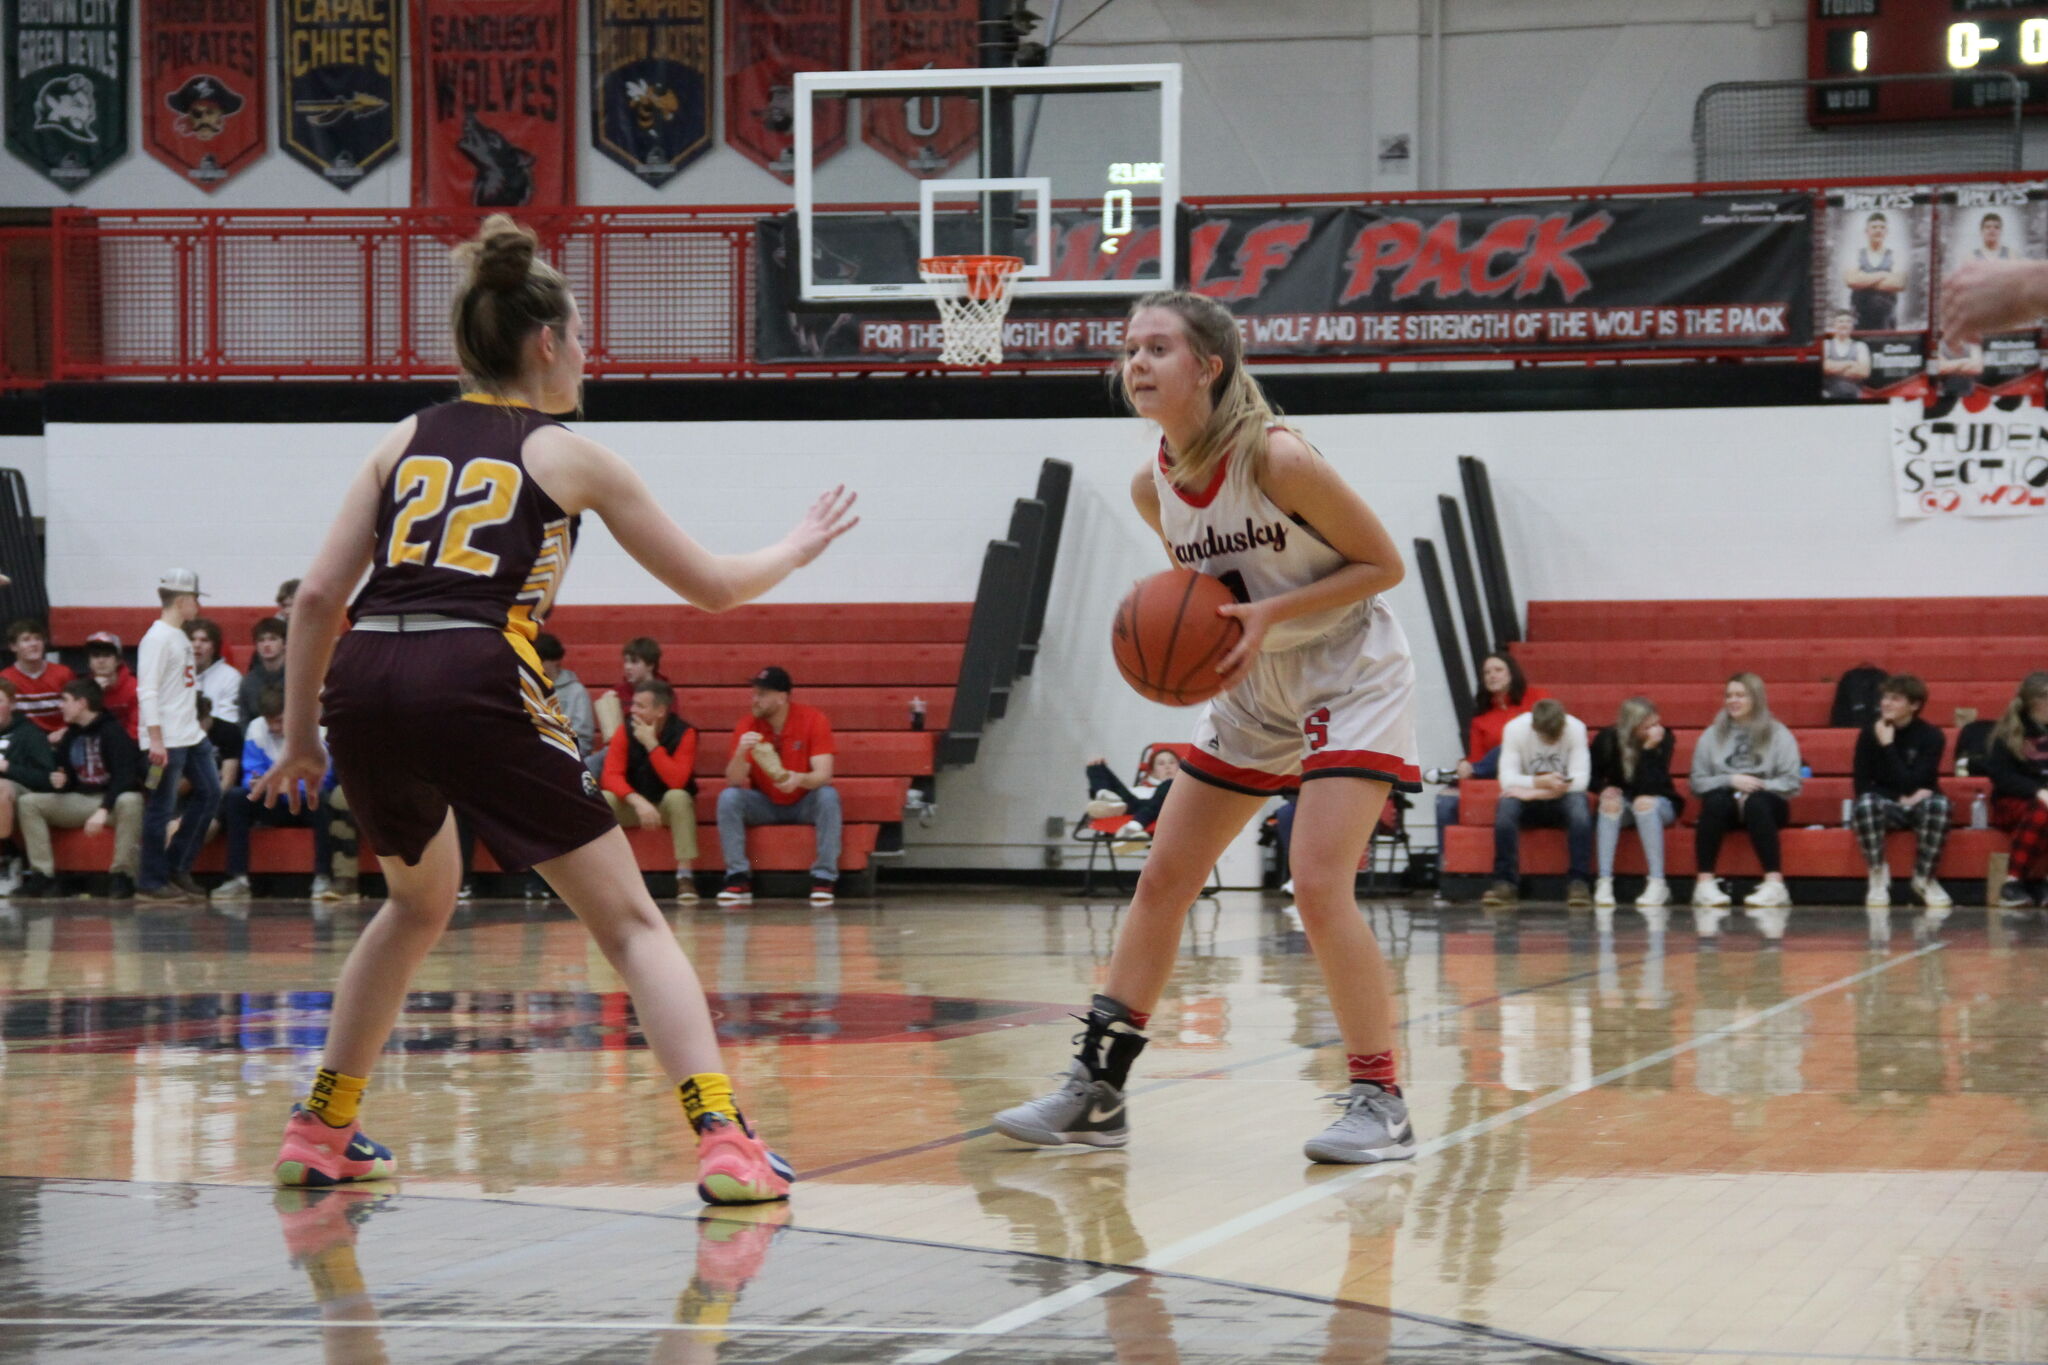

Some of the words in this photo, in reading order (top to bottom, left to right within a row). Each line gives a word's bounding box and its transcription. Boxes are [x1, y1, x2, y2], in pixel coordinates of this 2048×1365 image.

[152, 31, 254, 77] PIRATES
[293, 28, 391, 77] CHIEFS
[431, 14, 557, 53] SANDUSKY
[433, 57, 558, 123] WOLVES
[1340, 212, 1613, 305] PACK
[864, 324, 903, 348] FOR
[909, 323, 944, 348] THE
[1054, 321, 1081, 346] OF
[1086, 321, 1124, 347] THE
[1252, 316, 1312, 342] WOLF
[1315, 316, 1356, 341] AND
[1362, 316, 1400, 340] THE
[1405, 313, 1510, 340] STRENGTH
[1514, 313, 1542, 338] OF
[1548, 311, 1587, 337] THE
[1592, 310, 1654, 336] WOLF
[1657, 310, 1677, 335] IS
[1683, 308, 1723, 334] THE
[1727, 306, 1785, 333] PACK
[387, 455, 523, 577] 22
[1168, 517, 1288, 565] andusky
[1303, 706, 1332, 751] S
